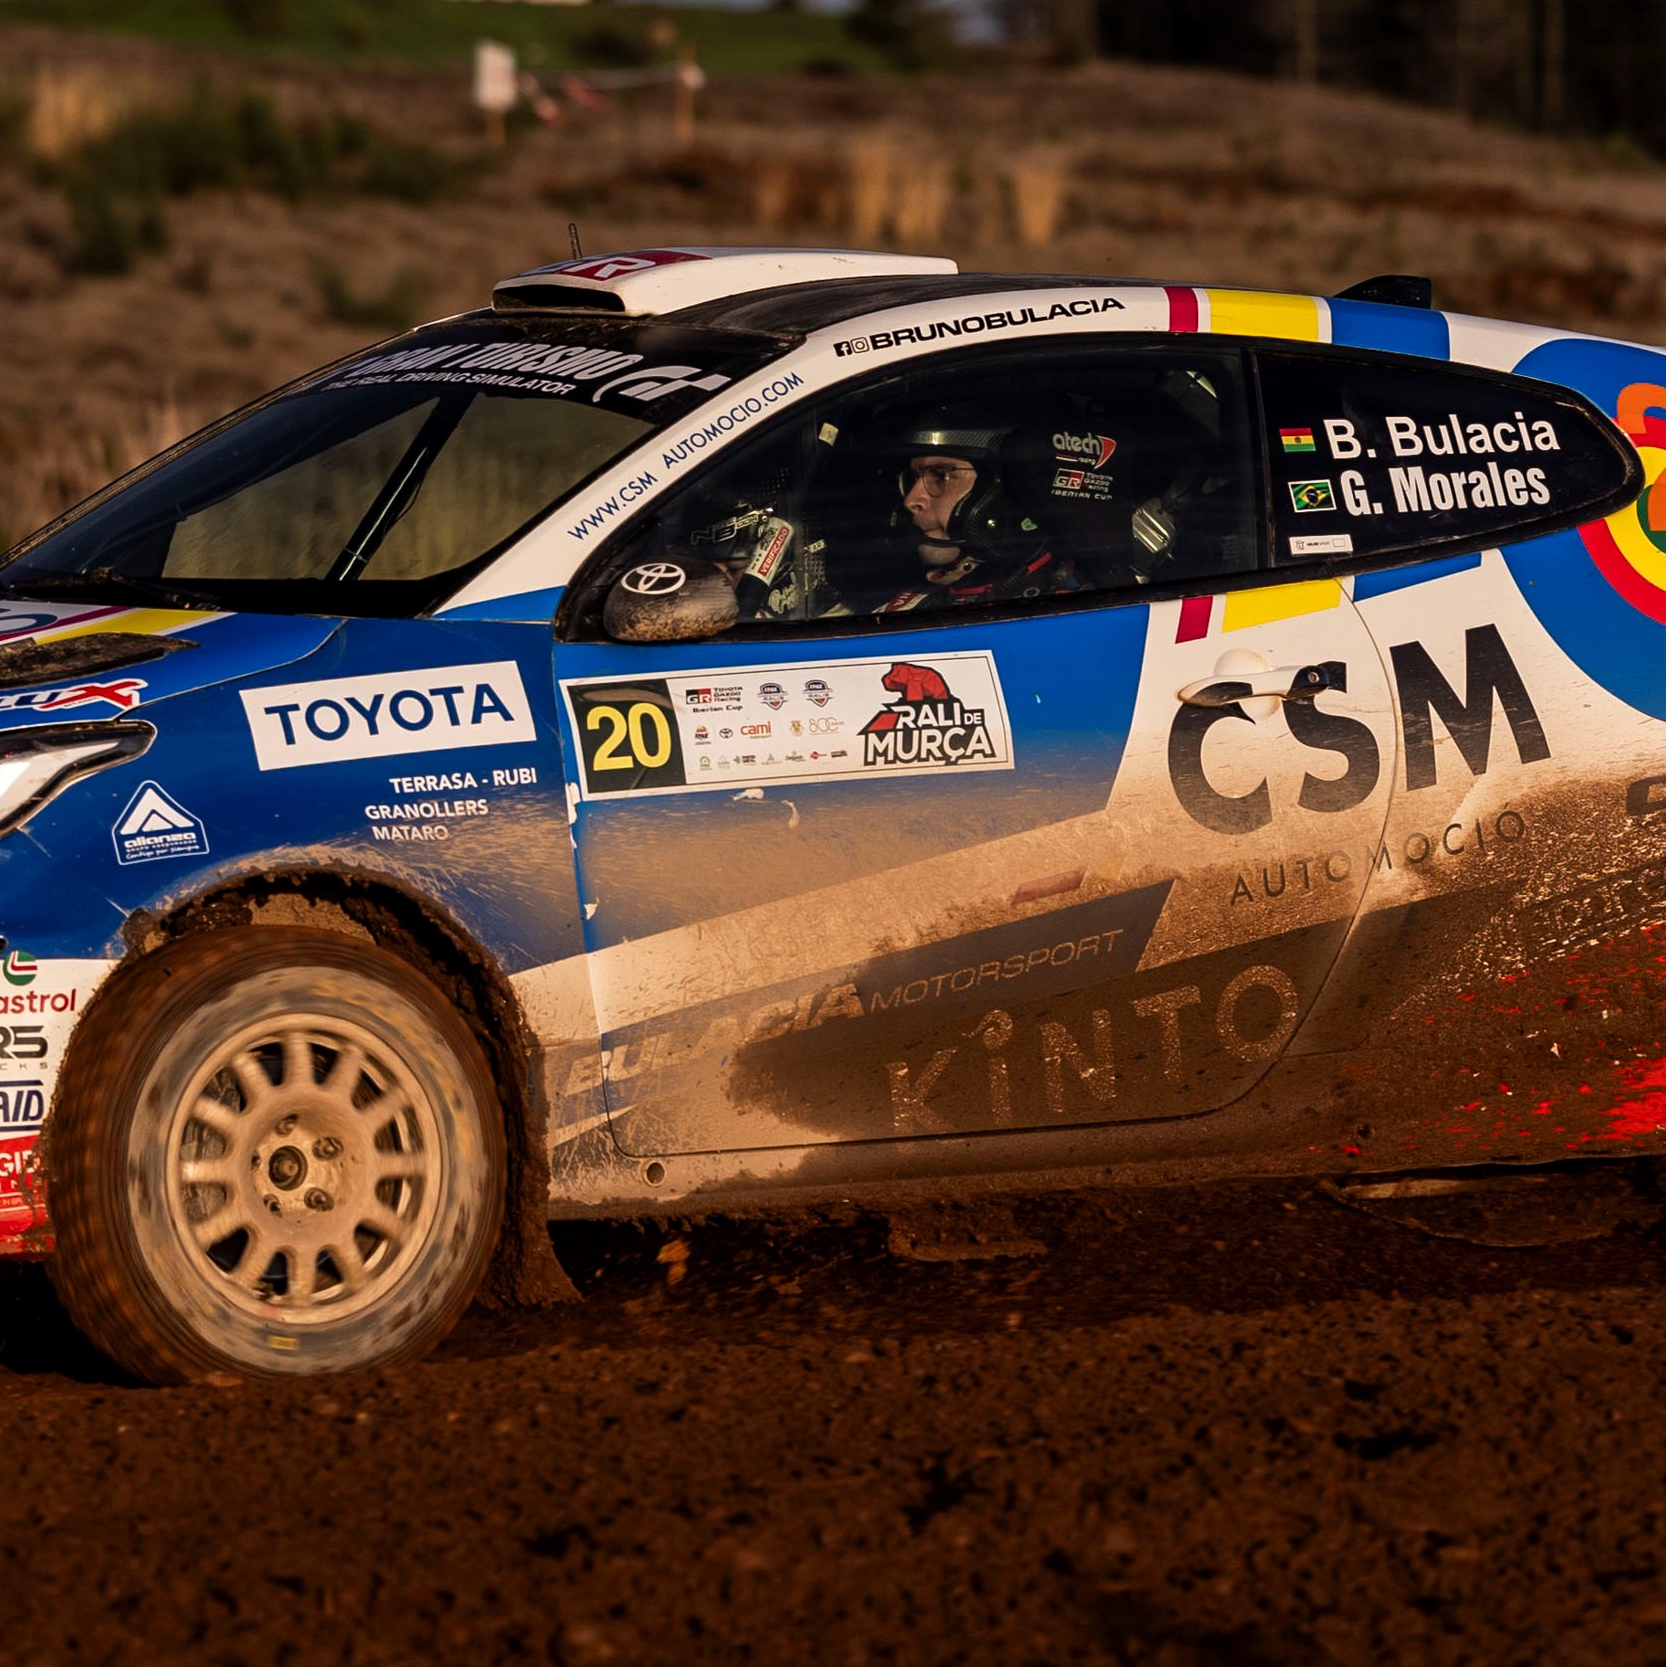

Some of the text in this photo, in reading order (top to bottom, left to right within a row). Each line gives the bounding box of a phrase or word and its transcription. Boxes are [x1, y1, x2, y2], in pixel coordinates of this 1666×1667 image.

[869, 297, 1126, 350] BRUNOBULACIA
[394, 372, 471, 383] DRIVING
[465, 373, 576, 395] SIMULATOR
[440, 343, 644, 380] TURISMO
[661, 371, 805, 470] AUTOMOCIO.COM
[1323, 411, 1561, 460] B. Bulacia
[1339, 462, 1551, 517] G. Morales
[264, 683, 515, 746] TOYOTA
[586, 702, 672, 772] 20
[894, 702, 983, 729] RALI DE
[1167, 623, 1551, 835] CSM
[867, 729, 992, 764] MURÇA
[389, 772, 477, 794] TERRASA
[493, 768, 537, 787] RUBI
[364, 799, 489, 820] GRANOLLERS
[371, 824, 450, 841] MATARO
[1230, 804, 1528, 907] AUTOMOCIÓ
[870, 929, 1124, 1011] MOTORSPORT
